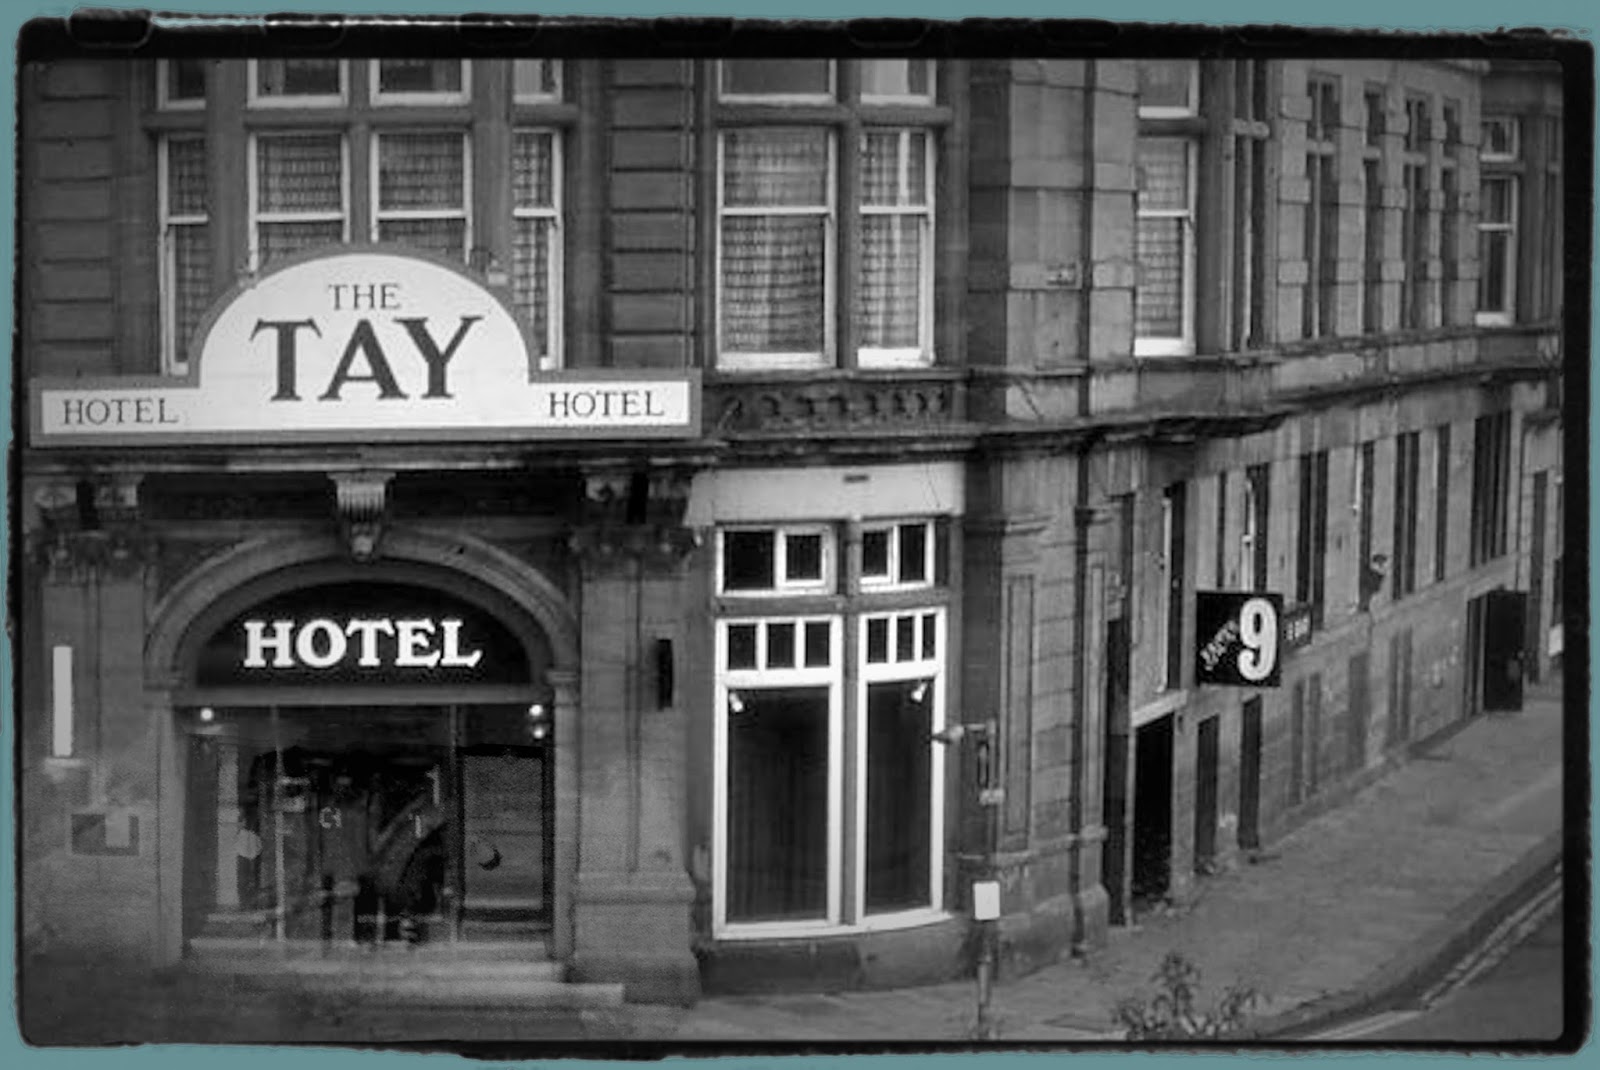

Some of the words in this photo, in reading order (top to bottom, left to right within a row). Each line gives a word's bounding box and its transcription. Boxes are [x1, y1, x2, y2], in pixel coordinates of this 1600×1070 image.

[328, 283, 401, 310] THE
[249, 315, 484, 402] TAY
[62, 398, 180, 426] HOTEL
[548, 391, 665, 419] HOTEL
[243, 618, 482, 668] HOTEL
[1237, 597, 1278, 681] 9
